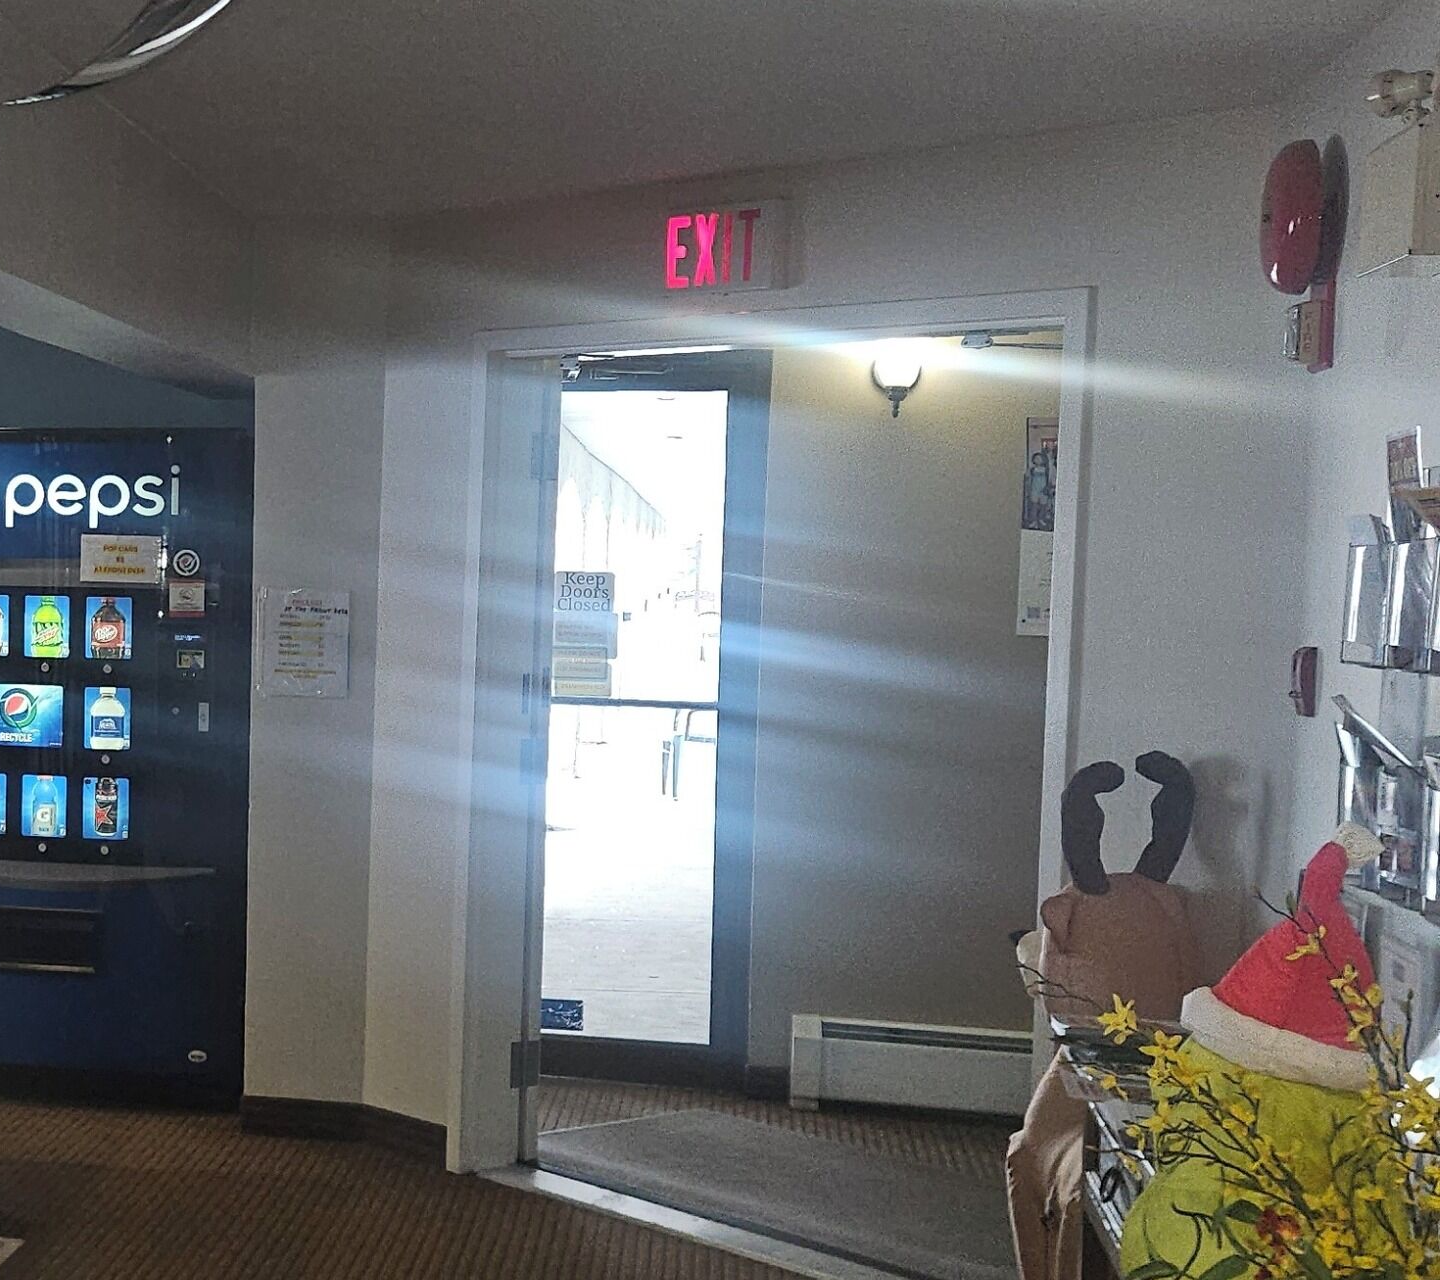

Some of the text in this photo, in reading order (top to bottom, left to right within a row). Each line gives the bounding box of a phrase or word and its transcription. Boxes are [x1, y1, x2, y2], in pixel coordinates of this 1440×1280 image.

[665, 208, 761, 289] EXIT
[5, 464, 181, 529] pepsi
[565, 572, 606, 588] Keep
[561, 585, 609, 599] Doors
[558, 598, 611, 612] Closed
[0, 732, 33, 743] RECYCLE
